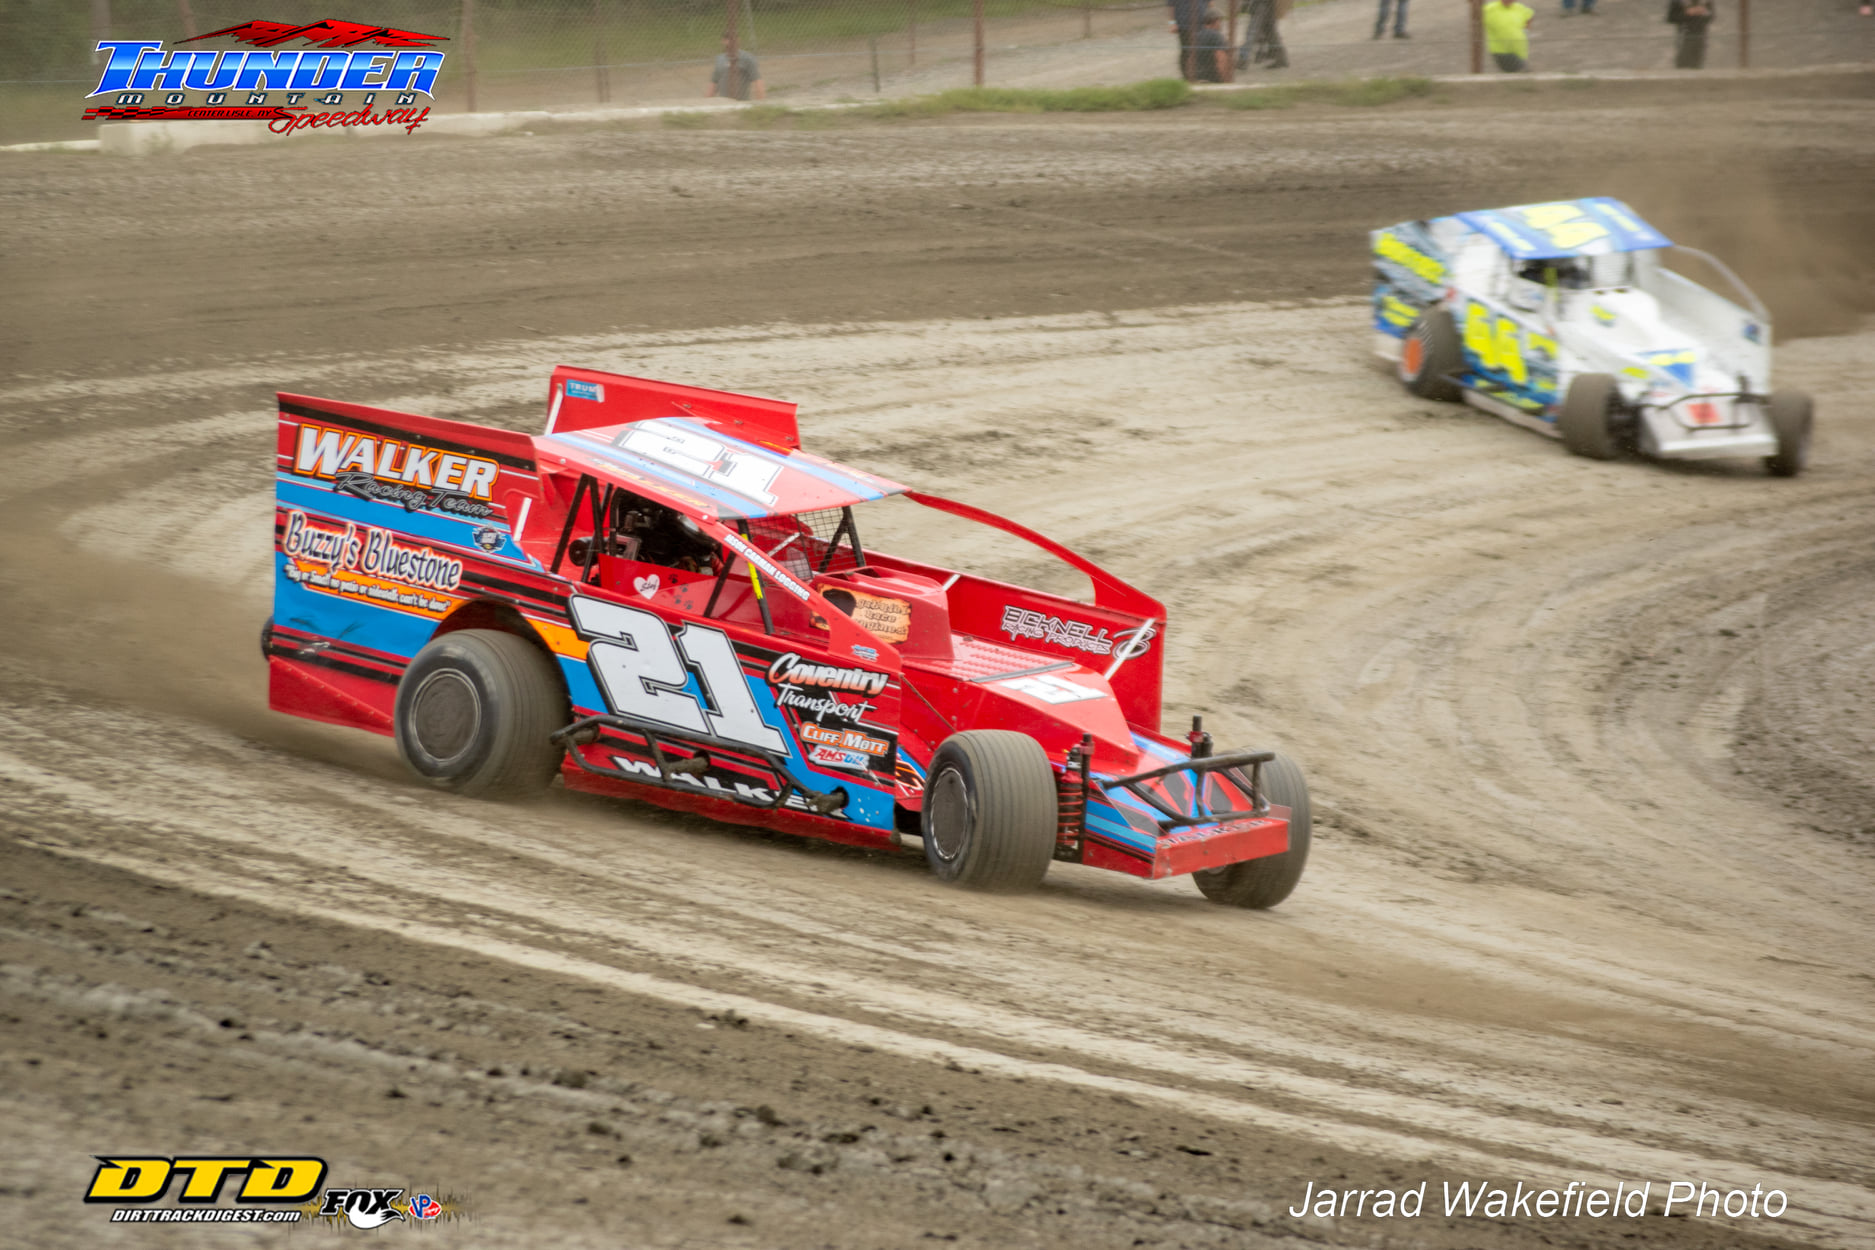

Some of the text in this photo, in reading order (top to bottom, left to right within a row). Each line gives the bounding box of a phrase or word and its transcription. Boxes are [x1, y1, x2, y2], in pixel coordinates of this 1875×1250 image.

[293, 423, 500, 502] WALKER
[334, 471, 494, 518] Racing Team
[284, 509, 360, 570] Buzzy's
[361, 526, 465, 591] Bluestone
[1001, 622, 1112, 655] RACING PRODUCTS
[1002, 605, 1113, 646] BICKNELL
[570, 593, 793, 759] 21
[767, 651, 889, 697] Coventry
[776, 683, 878, 724] Transport
[802, 724, 839, 745] CLIFF
